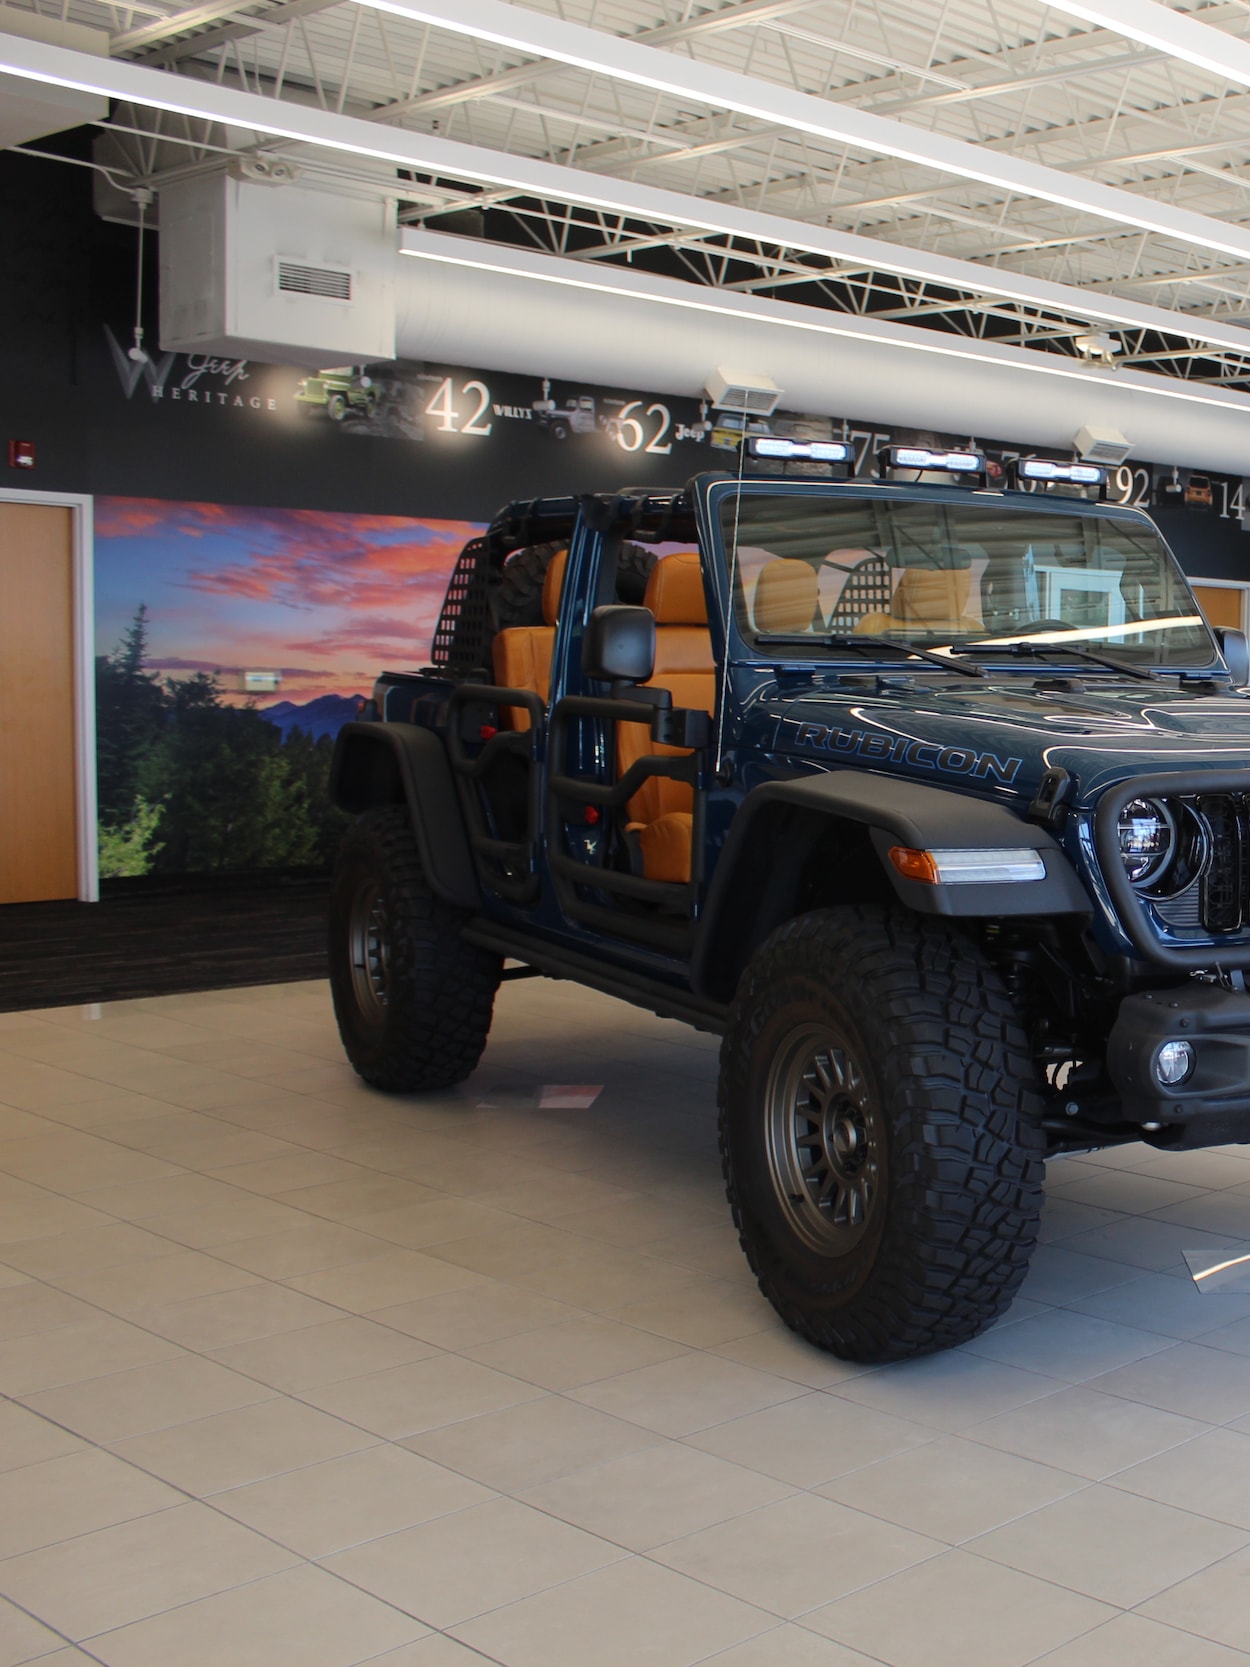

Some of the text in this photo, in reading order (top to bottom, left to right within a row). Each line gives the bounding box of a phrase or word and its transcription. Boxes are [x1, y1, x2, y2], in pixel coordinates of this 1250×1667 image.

[152, 384, 278, 411] HERITAGE
[425, 376, 493, 437] 42
[616, 400, 705, 455] 62 Jeep
[1116, 466, 1150, 508] 92
[1219, 481, 1246, 521] 14
[794, 721, 1023, 784] RUBICON
